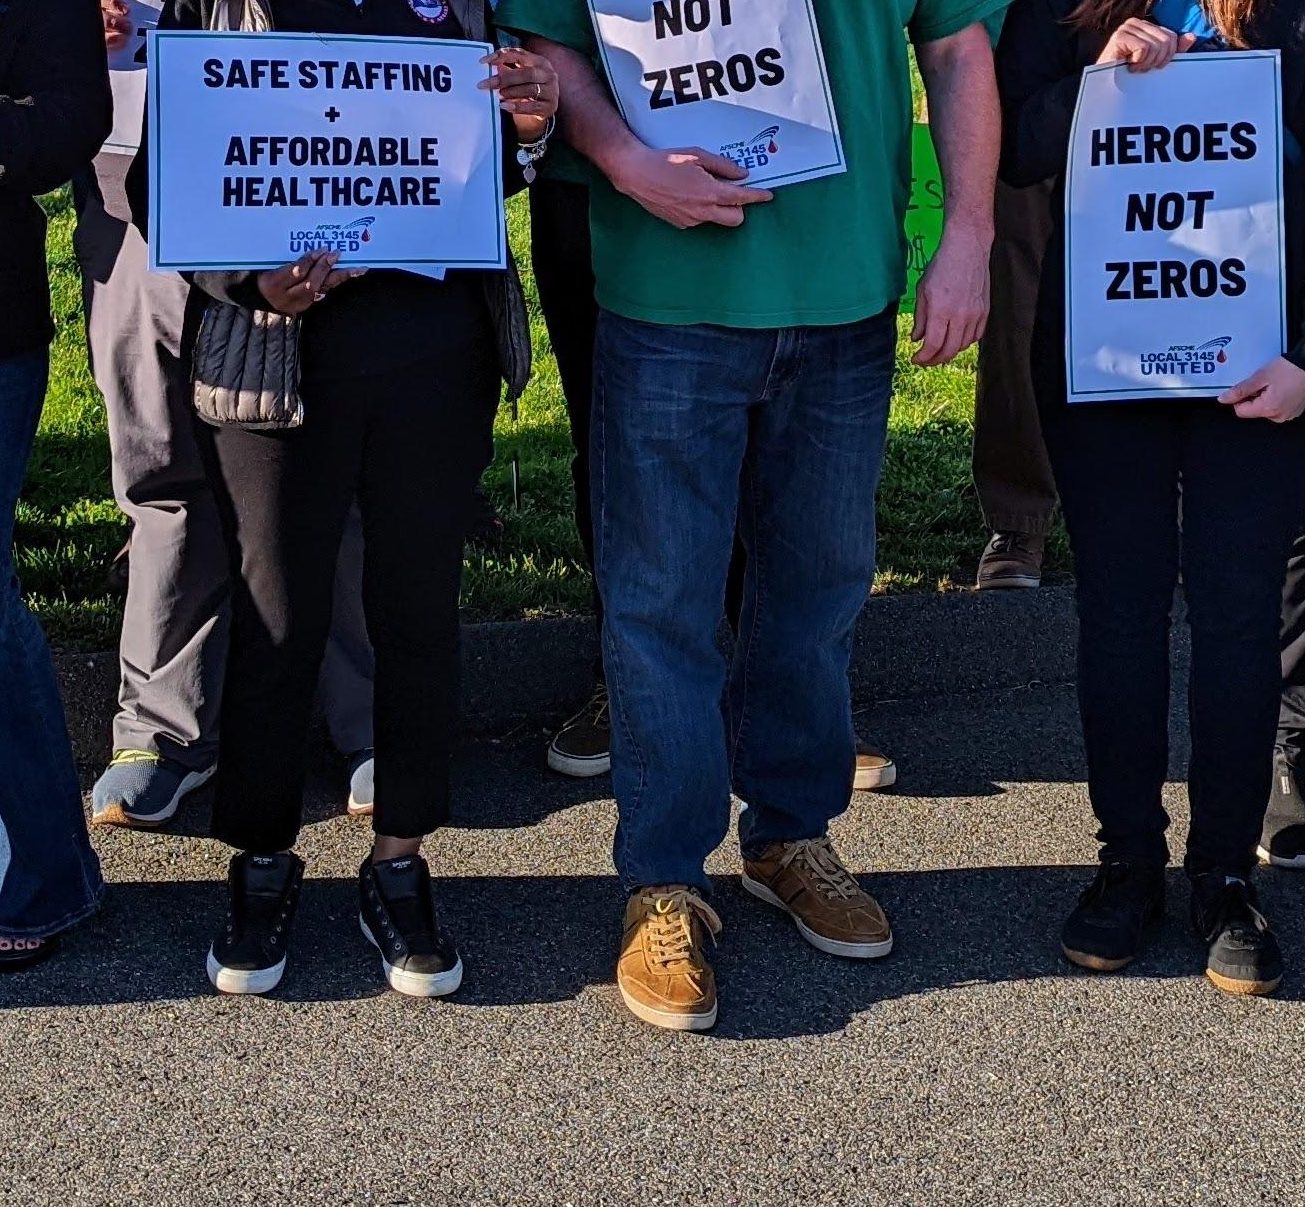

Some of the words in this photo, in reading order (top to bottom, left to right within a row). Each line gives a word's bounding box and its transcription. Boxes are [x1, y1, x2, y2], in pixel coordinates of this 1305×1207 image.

[203, 58, 289, 89] SAFE
[298, 60, 452, 93] STAFFING
[643, 47, 785, 110] ZEROS
[324, 106, 340, 123] +
[224, 136, 439, 167] AFFORDABLE
[737, 144, 767, 158] 3145
[1091, 121, 1257, 167] HEROES
[223, 177, 441, 207] HEALTHCARE
[1125, 190, 1215, 232] NOT
[290, 231, 328, 240] LOCAL
[332, 230, 359, 240] 3145
[1105, 257, 1247, 300] ZEROS
[1140, 352, 1181, 363] LOCAL
[1184, 351, 1214, 361] 3145
[1140, 362, 1216, 375] UNITED
